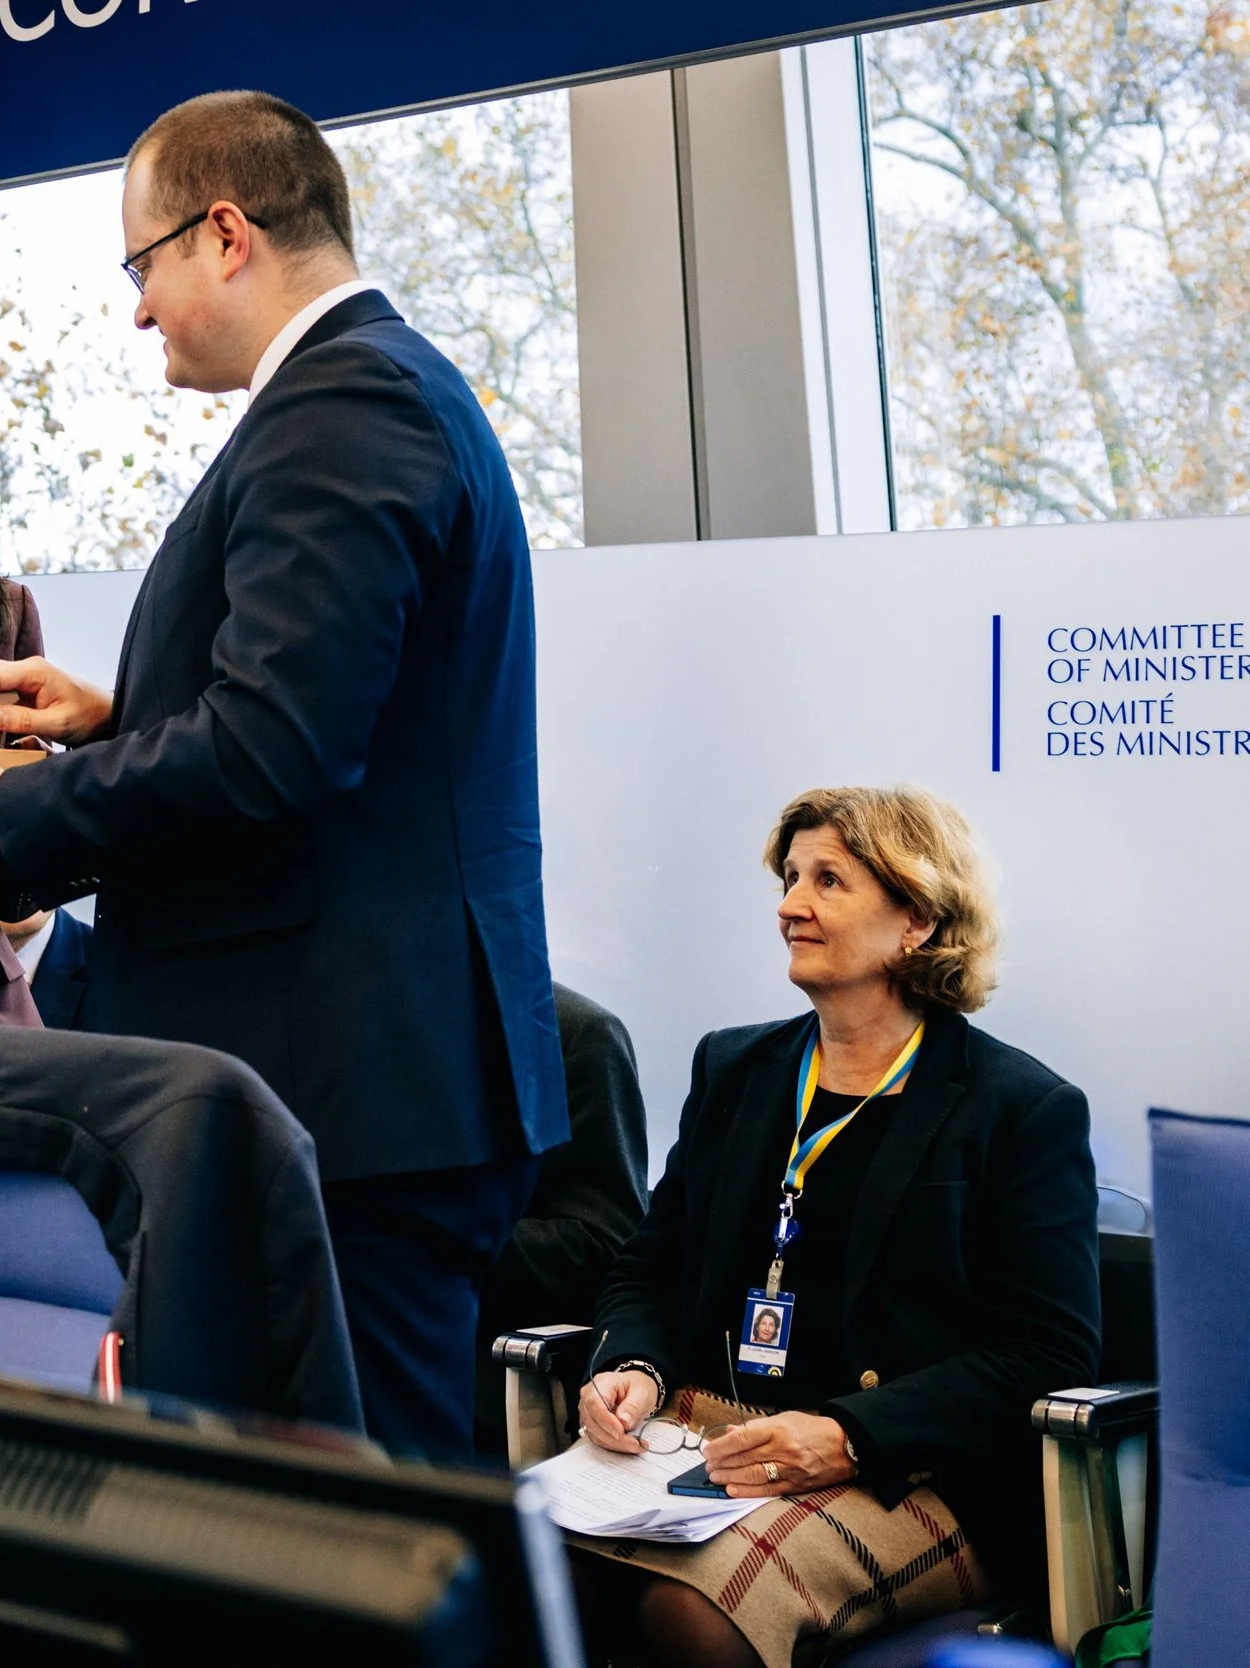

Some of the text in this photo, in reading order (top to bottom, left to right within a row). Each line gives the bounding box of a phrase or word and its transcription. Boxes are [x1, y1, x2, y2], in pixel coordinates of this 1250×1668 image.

[1048, 623, 1244, 652] COMMITTEE
[1048, 655, 1250, 683] OF MINISTER
[1048, 692, 1174, 725] COMITÉ
[1048, 730, 1250, 756] DES MINISTR
